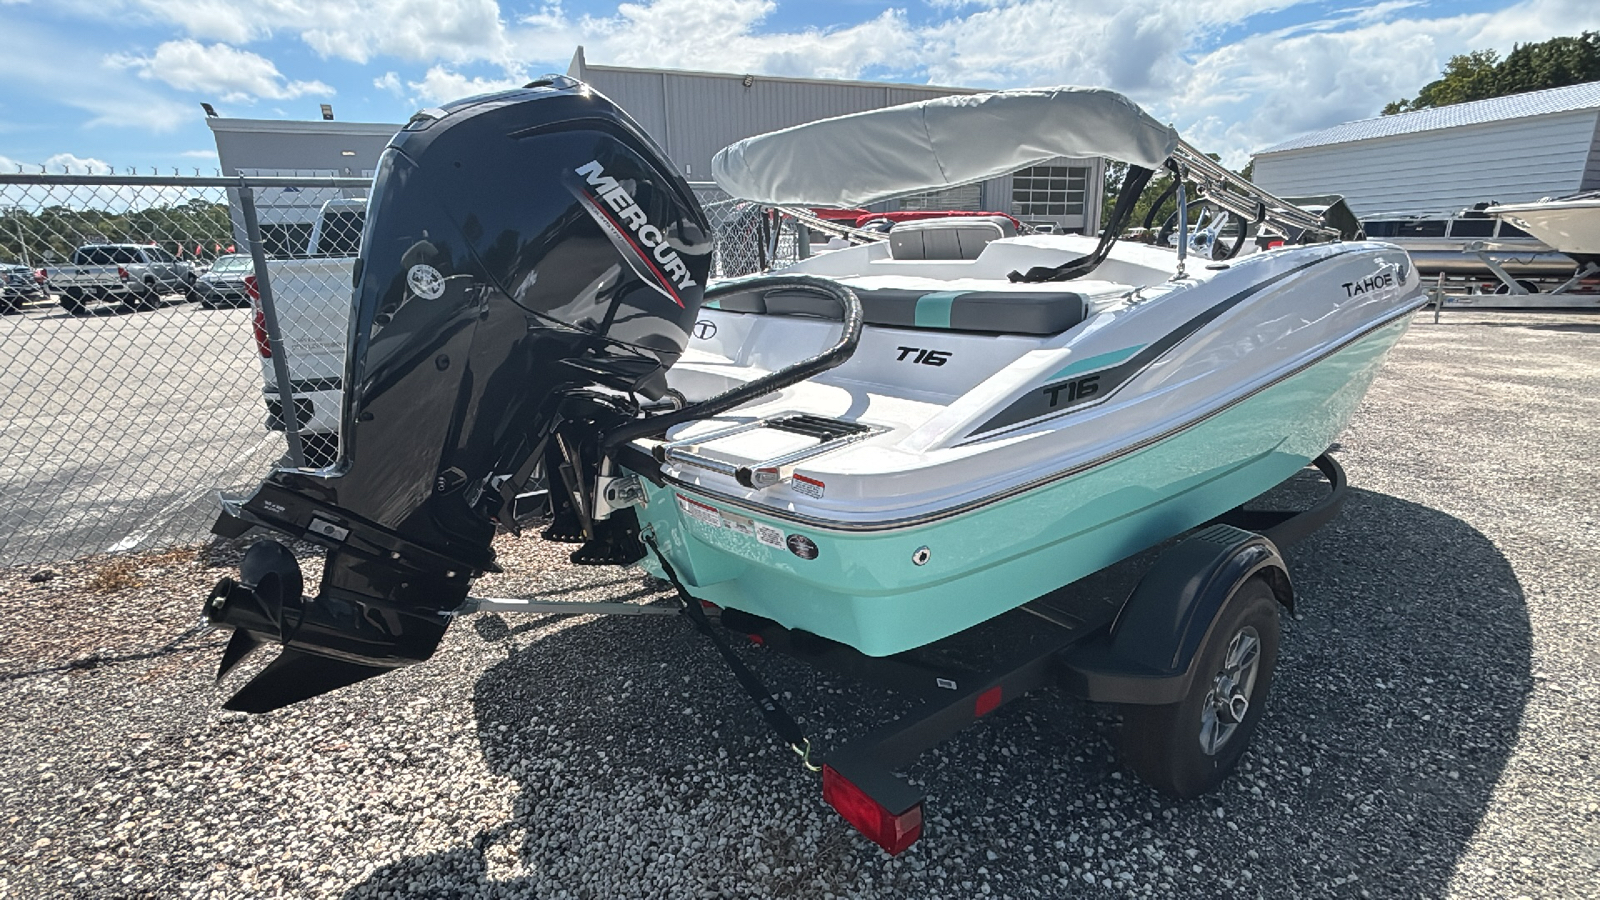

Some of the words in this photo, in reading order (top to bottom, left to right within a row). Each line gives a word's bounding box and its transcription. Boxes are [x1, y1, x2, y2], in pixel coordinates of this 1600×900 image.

[574, 159, 697, 291] MERCURY
[1341, 273, 1392, 298] TAHOE
[896, 346, 953, 367] T16
[1043, 375, 1100, 407] T16
